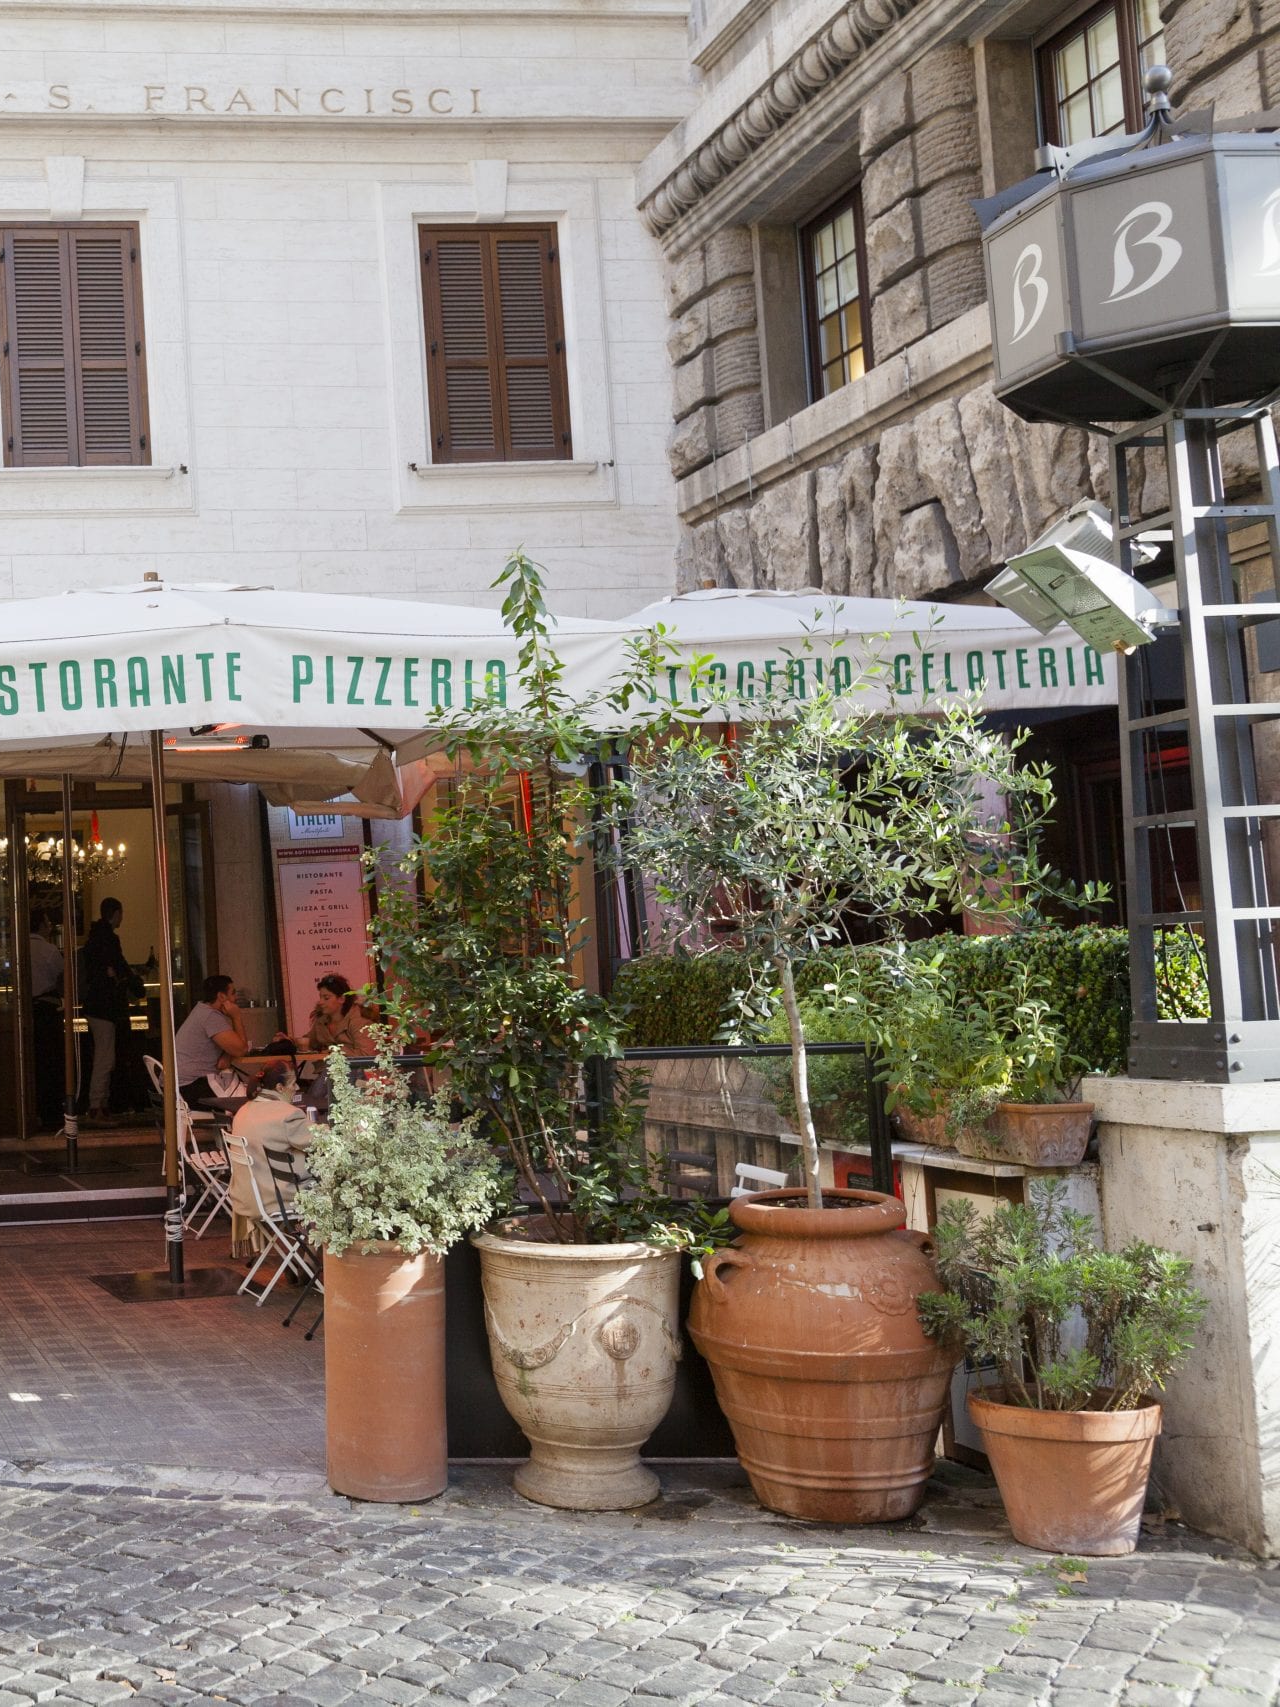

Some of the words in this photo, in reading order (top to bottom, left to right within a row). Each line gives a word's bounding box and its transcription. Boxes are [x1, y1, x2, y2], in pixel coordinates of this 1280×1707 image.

[144, 86, 484, 114] FRANCISCI
[292, 655, 508, 708] PIZZERIA
[894, 645, 1105, 695] GELATERIA
[296, 871, 343, 879] RISTORANTE
[308, 927, 353, 935] CARTOCCIO
